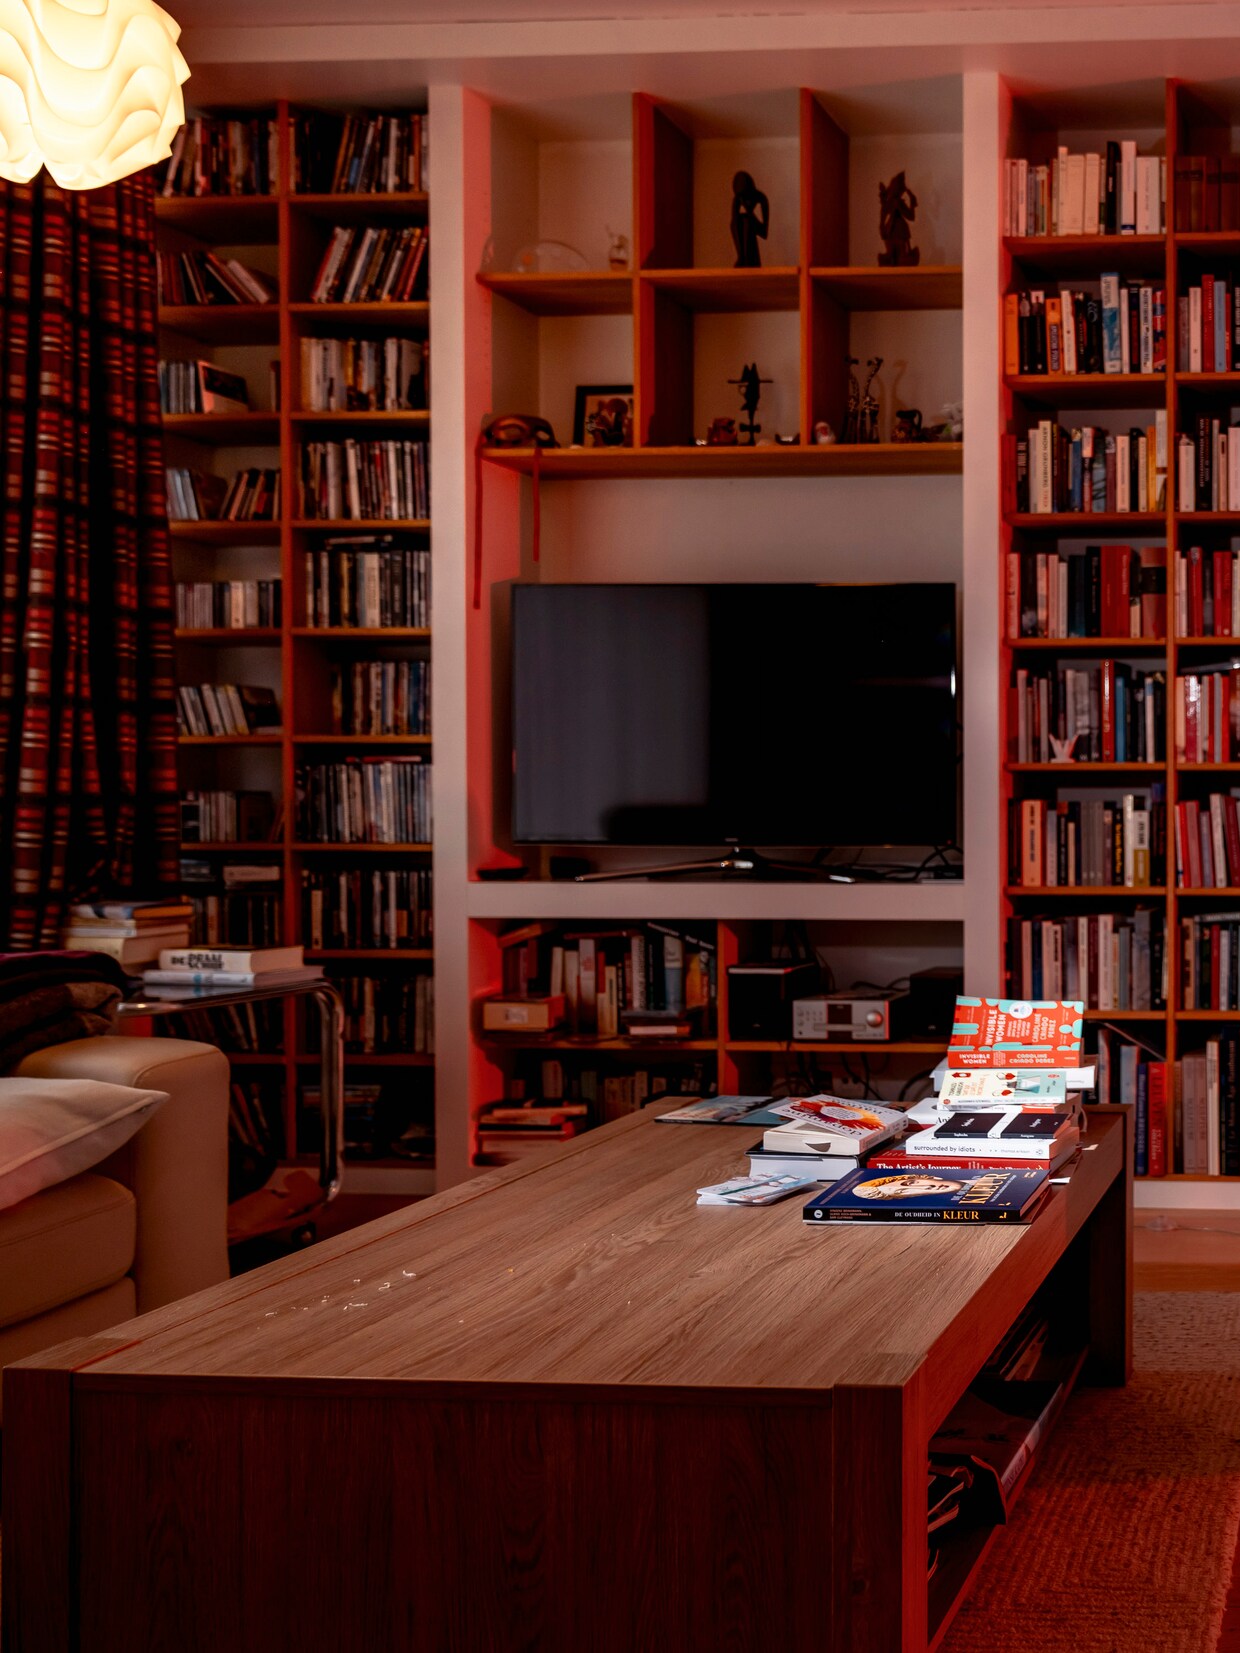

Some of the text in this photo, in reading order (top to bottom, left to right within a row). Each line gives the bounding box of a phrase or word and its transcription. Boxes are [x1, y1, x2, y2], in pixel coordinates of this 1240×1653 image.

[985, 1009, 997, 1045] INVISIBLE
[996, 1014, 1006, 1042] WOMEN
[1032, 1014, 1042, 1042] CAROLINE
[782, 1108, 862, 1137] dopamine
[958, 1172, 1012, 1204] KLEUR
[942, 1210, 980, 1220] KLEUR
